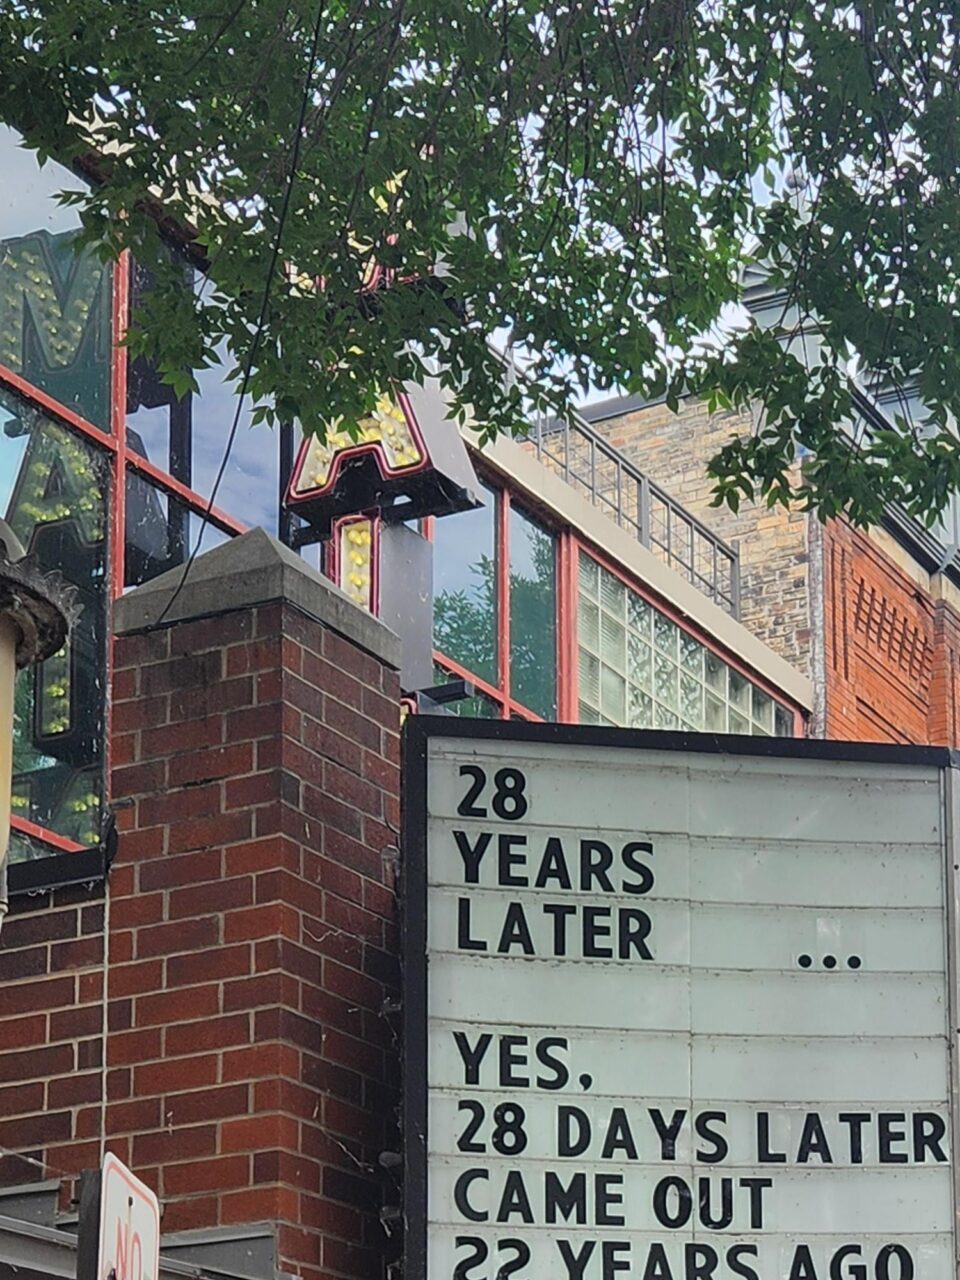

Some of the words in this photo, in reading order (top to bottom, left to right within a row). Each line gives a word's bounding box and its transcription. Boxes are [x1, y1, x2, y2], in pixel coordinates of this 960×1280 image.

[456, 764, 528, 821] 28
[451, 829, 655, 895] YEARS
[457, 896, 655, 961] LATER
[456, 1099, 528, 1157] 28
[557, 1104, 729, 1164] DAYS
[756, 1111, 949, 1165] LATER
[453, 1167, 626, 1227] CAME
[652, 1175, 773, 1231] OUT
